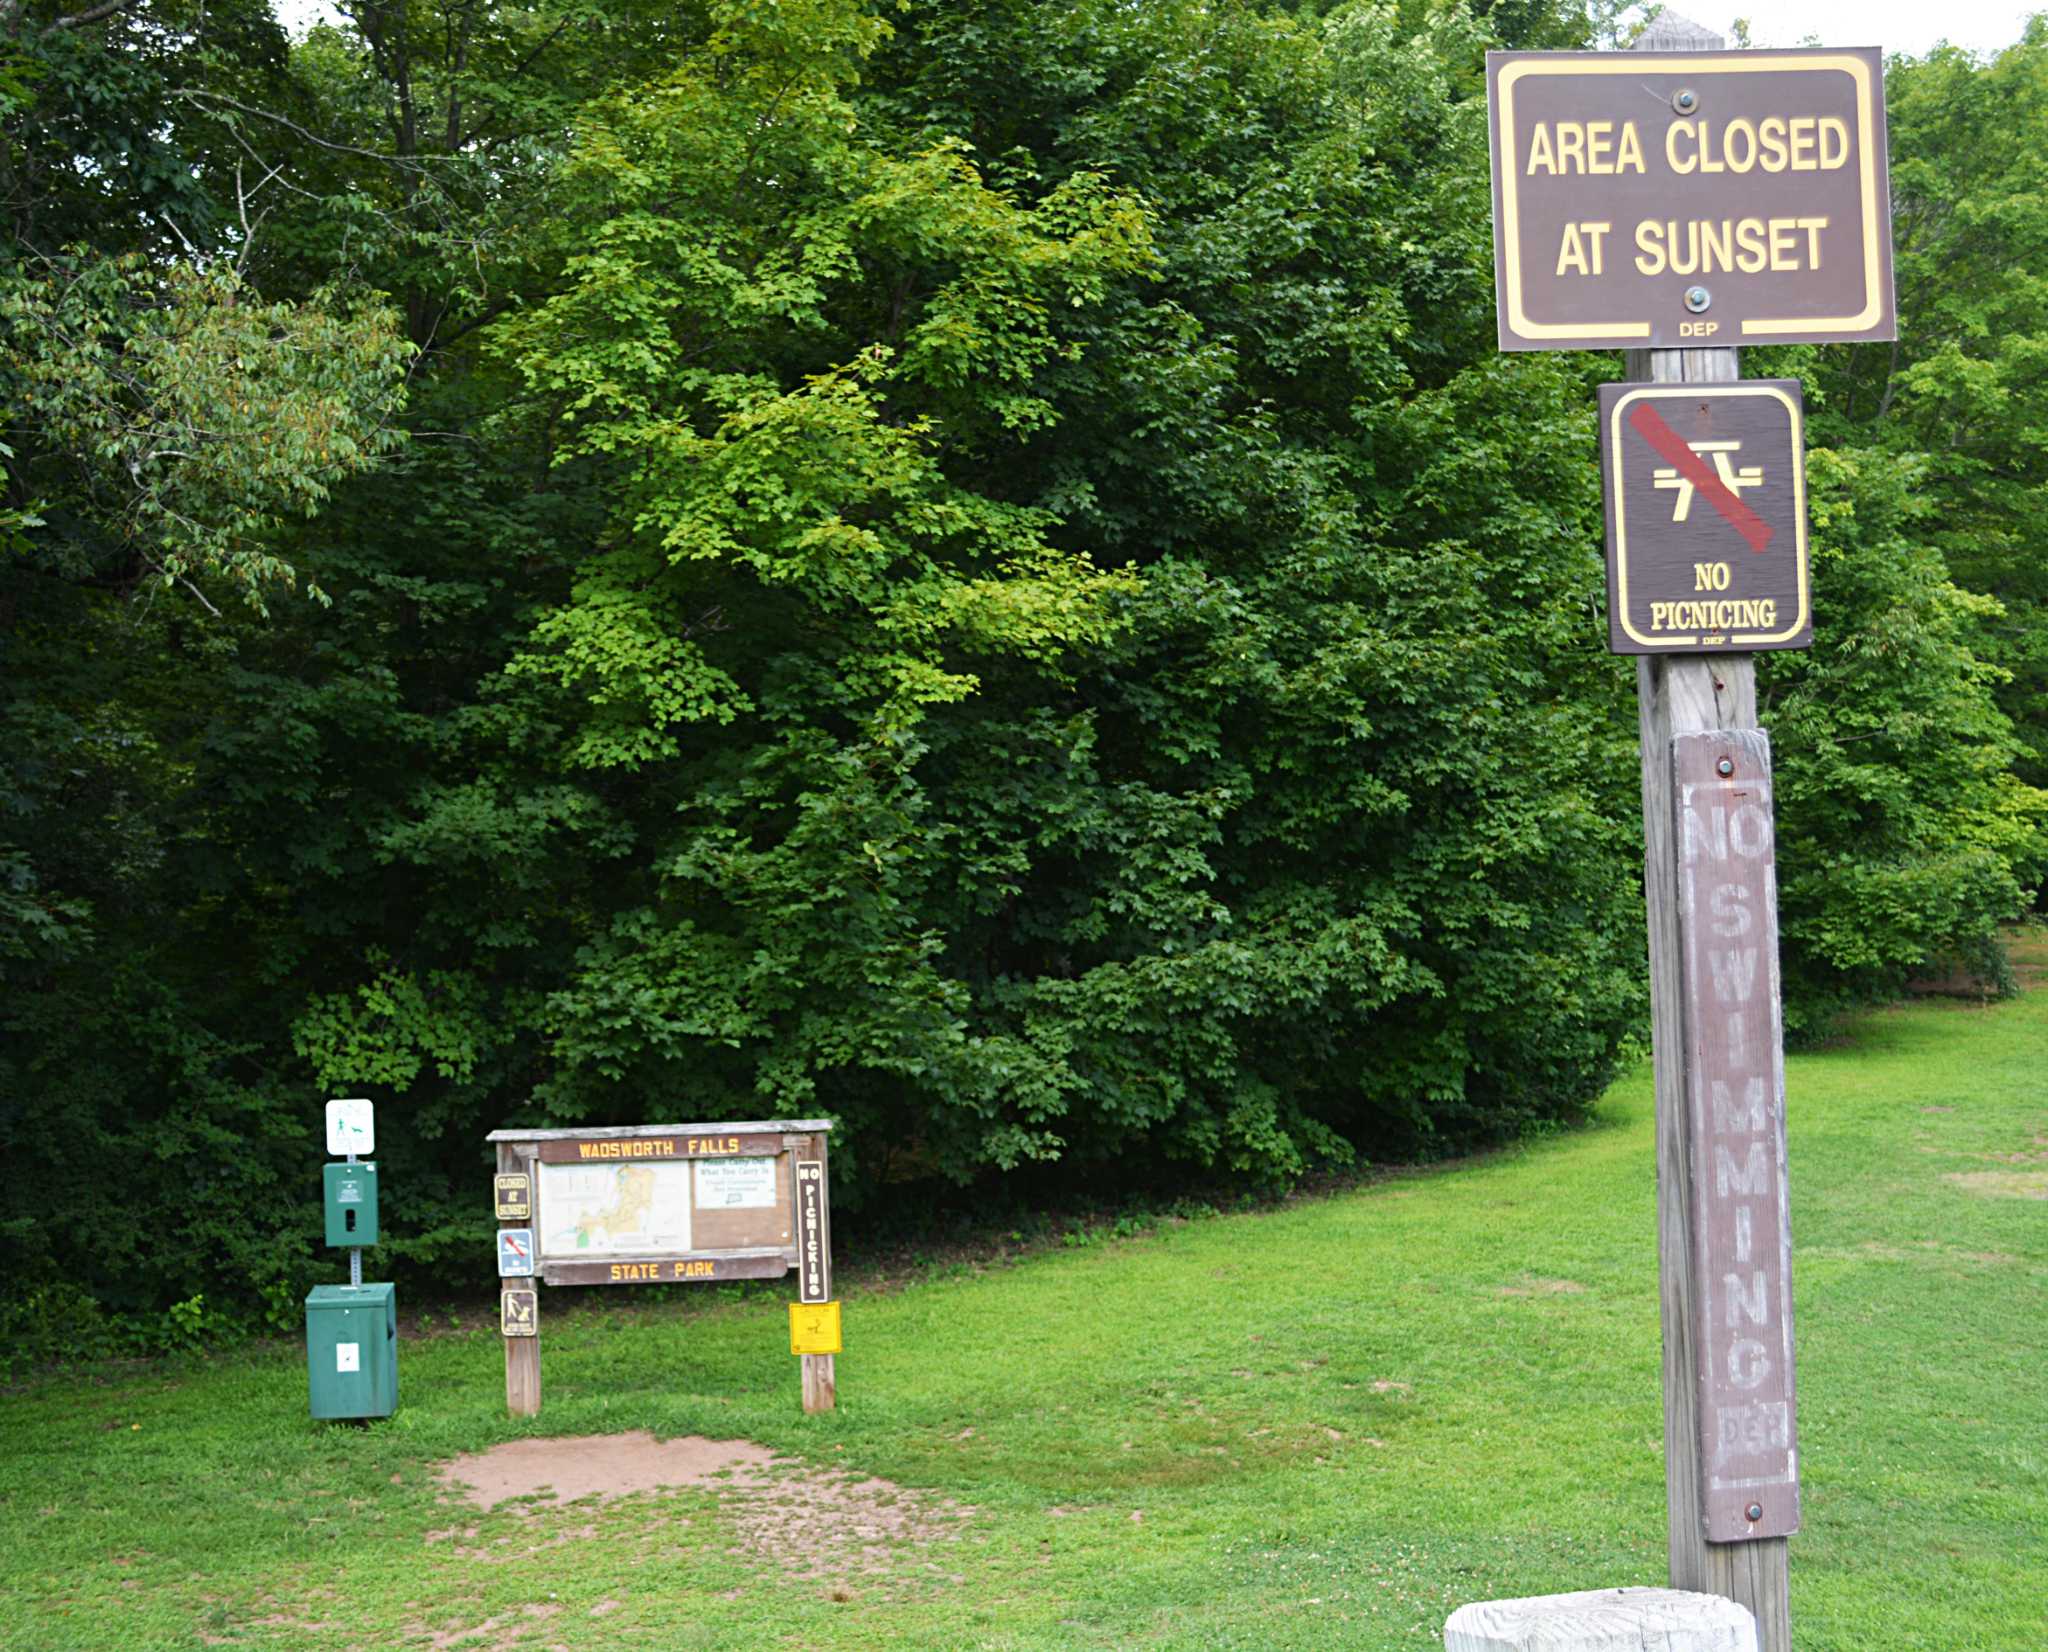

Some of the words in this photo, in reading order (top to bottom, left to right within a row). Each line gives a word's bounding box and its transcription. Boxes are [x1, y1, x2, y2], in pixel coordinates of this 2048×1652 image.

[1527, 121, 1645, 175] AREA
[1665, 118, 1849, 174] CLOSED
[1556, 223, 1610, 276] AT
[1635, 218, 1827, 276] SUNSET
[1679, 322, 1719, 337] DEP
[1694, 562, 1730, 591] NO
[1650, 599, 1777, 631] PICNICING
[1683, 804, 1769, 860] NO
[579, 1141, 673, 1158] WADSWORTH
[688, 1138, 739, 1155] FALLS
[1709, 883, 1771, 1390] SWIMMING
[498, 1178, 527, 1190] CLOSED
[799, 1168, 820, 1180] NO
[507, 1191, 518, 1202] AT
[499, 1204, 528, 1217] SUNSET
[806, 1185, 820, 1296] PICNICKING
[611, 1264, 659, 1280] STATE
[675, 1262, 715, 1277] PARK
